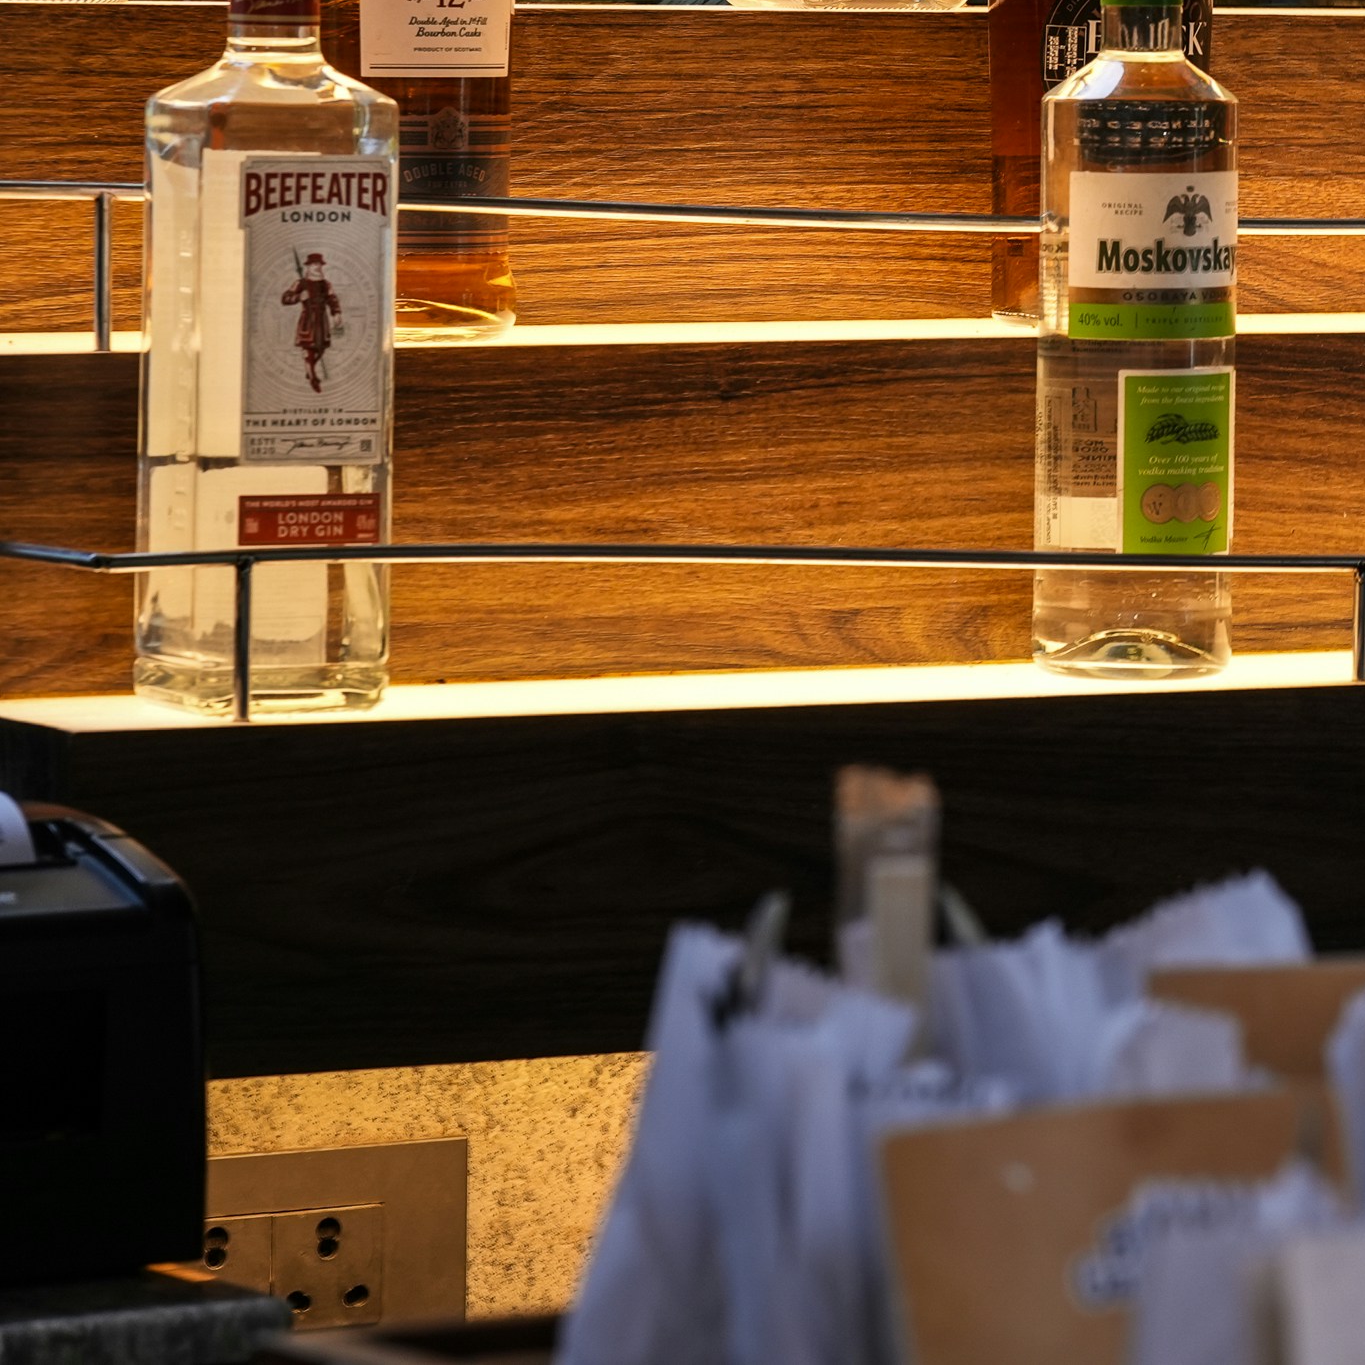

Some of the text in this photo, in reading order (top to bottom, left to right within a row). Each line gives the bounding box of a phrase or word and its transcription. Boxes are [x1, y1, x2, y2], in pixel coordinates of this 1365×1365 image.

[409, 16, 438, 26] Double
[416, 27, 481, 38] Bourbon Casks
[403, 162, 486, 183] DOUBLE AGED
[244, 172, 387, 217] BEEFEATER
[281, 211, 351, 223] LONDON
[1123, 291, 1197, 301] OSOBAYA
[1079, 313, 1123, 326] 40% vol.
[1137, 385, 1160, 394] Made
[1140, 396, 1193, 406] from the finest
[246, 419, 267, 427] THE
[271, 419, 308, 427] HEART
[330, 418, 377, 426] LONDON
[1149, 453, 1219, 466] Over 100 years of
[1138, 466, 1165, 476] vodka
[1167, 466, 1197, 477] making
[277, 512, 344, 524] LONDON
[277, 526, 310, 538] DRY
[315, 525, 344, 537] GIN
[1140, 535, 1162, 544] Vodka
